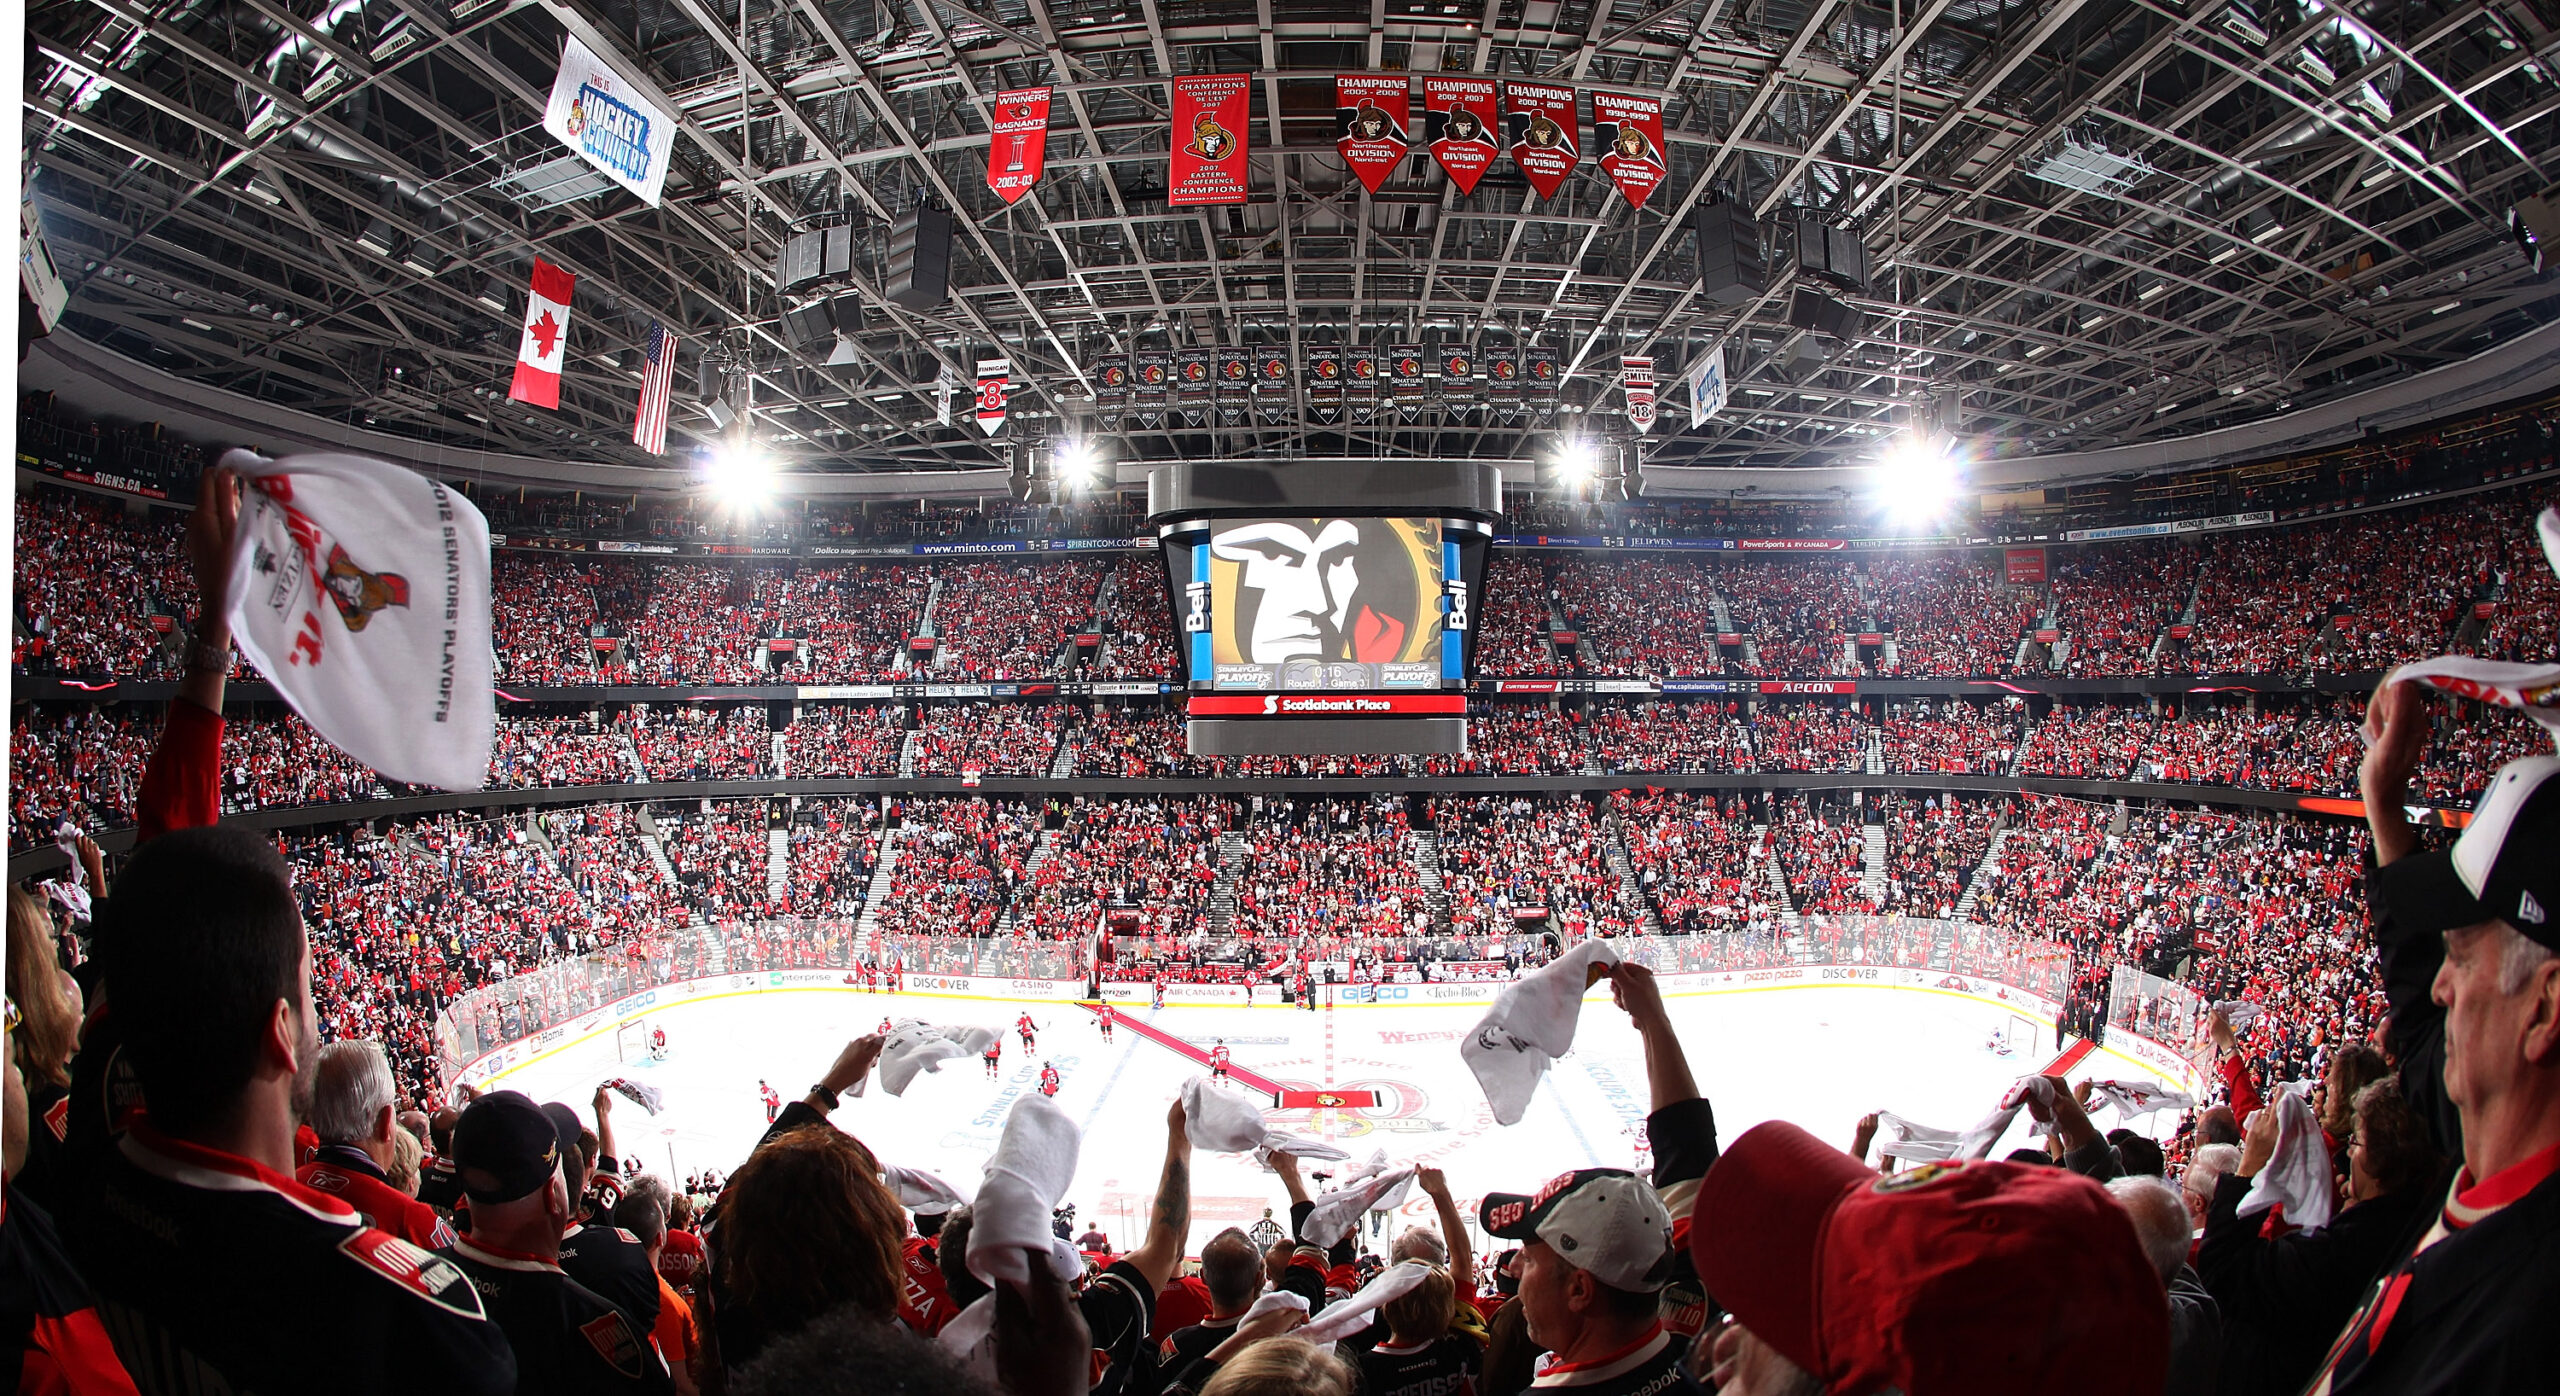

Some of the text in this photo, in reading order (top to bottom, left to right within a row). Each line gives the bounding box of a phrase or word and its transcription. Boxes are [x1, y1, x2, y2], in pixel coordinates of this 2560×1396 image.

[590, 74, 610, 91] THIS IS
[1178, 82, 1246, 91] CHAMPIONS
[1337, 78, 1407, 89] CHAMPIONS
[1427, 81, 1493, 93] CHAMPIONS
[1508, 85, 1572, 101] CHAMPIONS
[999, 94, 1049, 105] WINNERS
[1518, 98, 1564, 109] 2000 2001
[1595, 95, 1658, 114] CHAMPIONS
[582, 89, 644, 150] HOCKEY
[1605, 109, 1650, 121] 1998-1999
[994, 118, 1046, 130] GAGNANTS
[584, 119, 649, 178] COUNTRY
[1347, 150, 1395, 158] DIVISION
[1443, 153, 1485, 161] DIVISION
[1523, 158, 1566, 169] DIVISION
[1613, 168, 1654, 181] DIVISION
[996, 174, 1033, 188] 2002-03
[1173, 185, 1244, 195] CHAMPIONS
[978, 365, 1008, 373] FINNIGAN
[1624, 372, 1653, 381] SMITH
[982, 381, 1002, 410] 8
[1634, 405, 1649, 418] 18
[94, 471, 140, 492] SIGNS.CA
[2089, 526, 2167, 538] www.eventsonline.ca
[1067, 539, 1135, 549] SPIRENTCOM.COM
[1562, 538, 1580, 546] Energy
[1743, 540, 1785, 549] PowerSports
[712, 546, 752, 554] PRESTON
[923, 543, 1015, 553] www.minto.com
[442, 527, 460, 624] SENATORS'
[1186, 581, 1204, 632] Bell
[1449, 579, 1468, 630] Bell
[435, 629, 458, 723] PLAYOFFS
[1314, 666, 1342, 677] 0:16
[1383, 672, 1437, 681] PLAYOFFS
[1218, 673, 1272, 682] PLAYOFFS
[961, 685, 979, 694] HELIX
[1331, 680, 1357, 688] Game
[928, 686, 946, 694] HELIX
[1283, 699, 1391, 710] Scotiabank Place
[1744, 970, 1802, 984] pizza pizza
[1822, 969, 1878, 979] DISCOVER
[913, 977, 969, 990] DISCOVER
[1012, 980, 1053, 989] CASINO
[1099, 988, 1131, 998] verizon
[1342, 986, 1408, 999] GECO
[616, 991, 656, 1016] GEICO
[542, 1027, 564, 1043] Home
[2136, 1041, 2155, 1059] bulk
[1218, 1052, 1228, 1061] 18
[1047, 1074, 1057, 1085] 15
[972, 1066, 1036, 1127] STANLEY CUP
